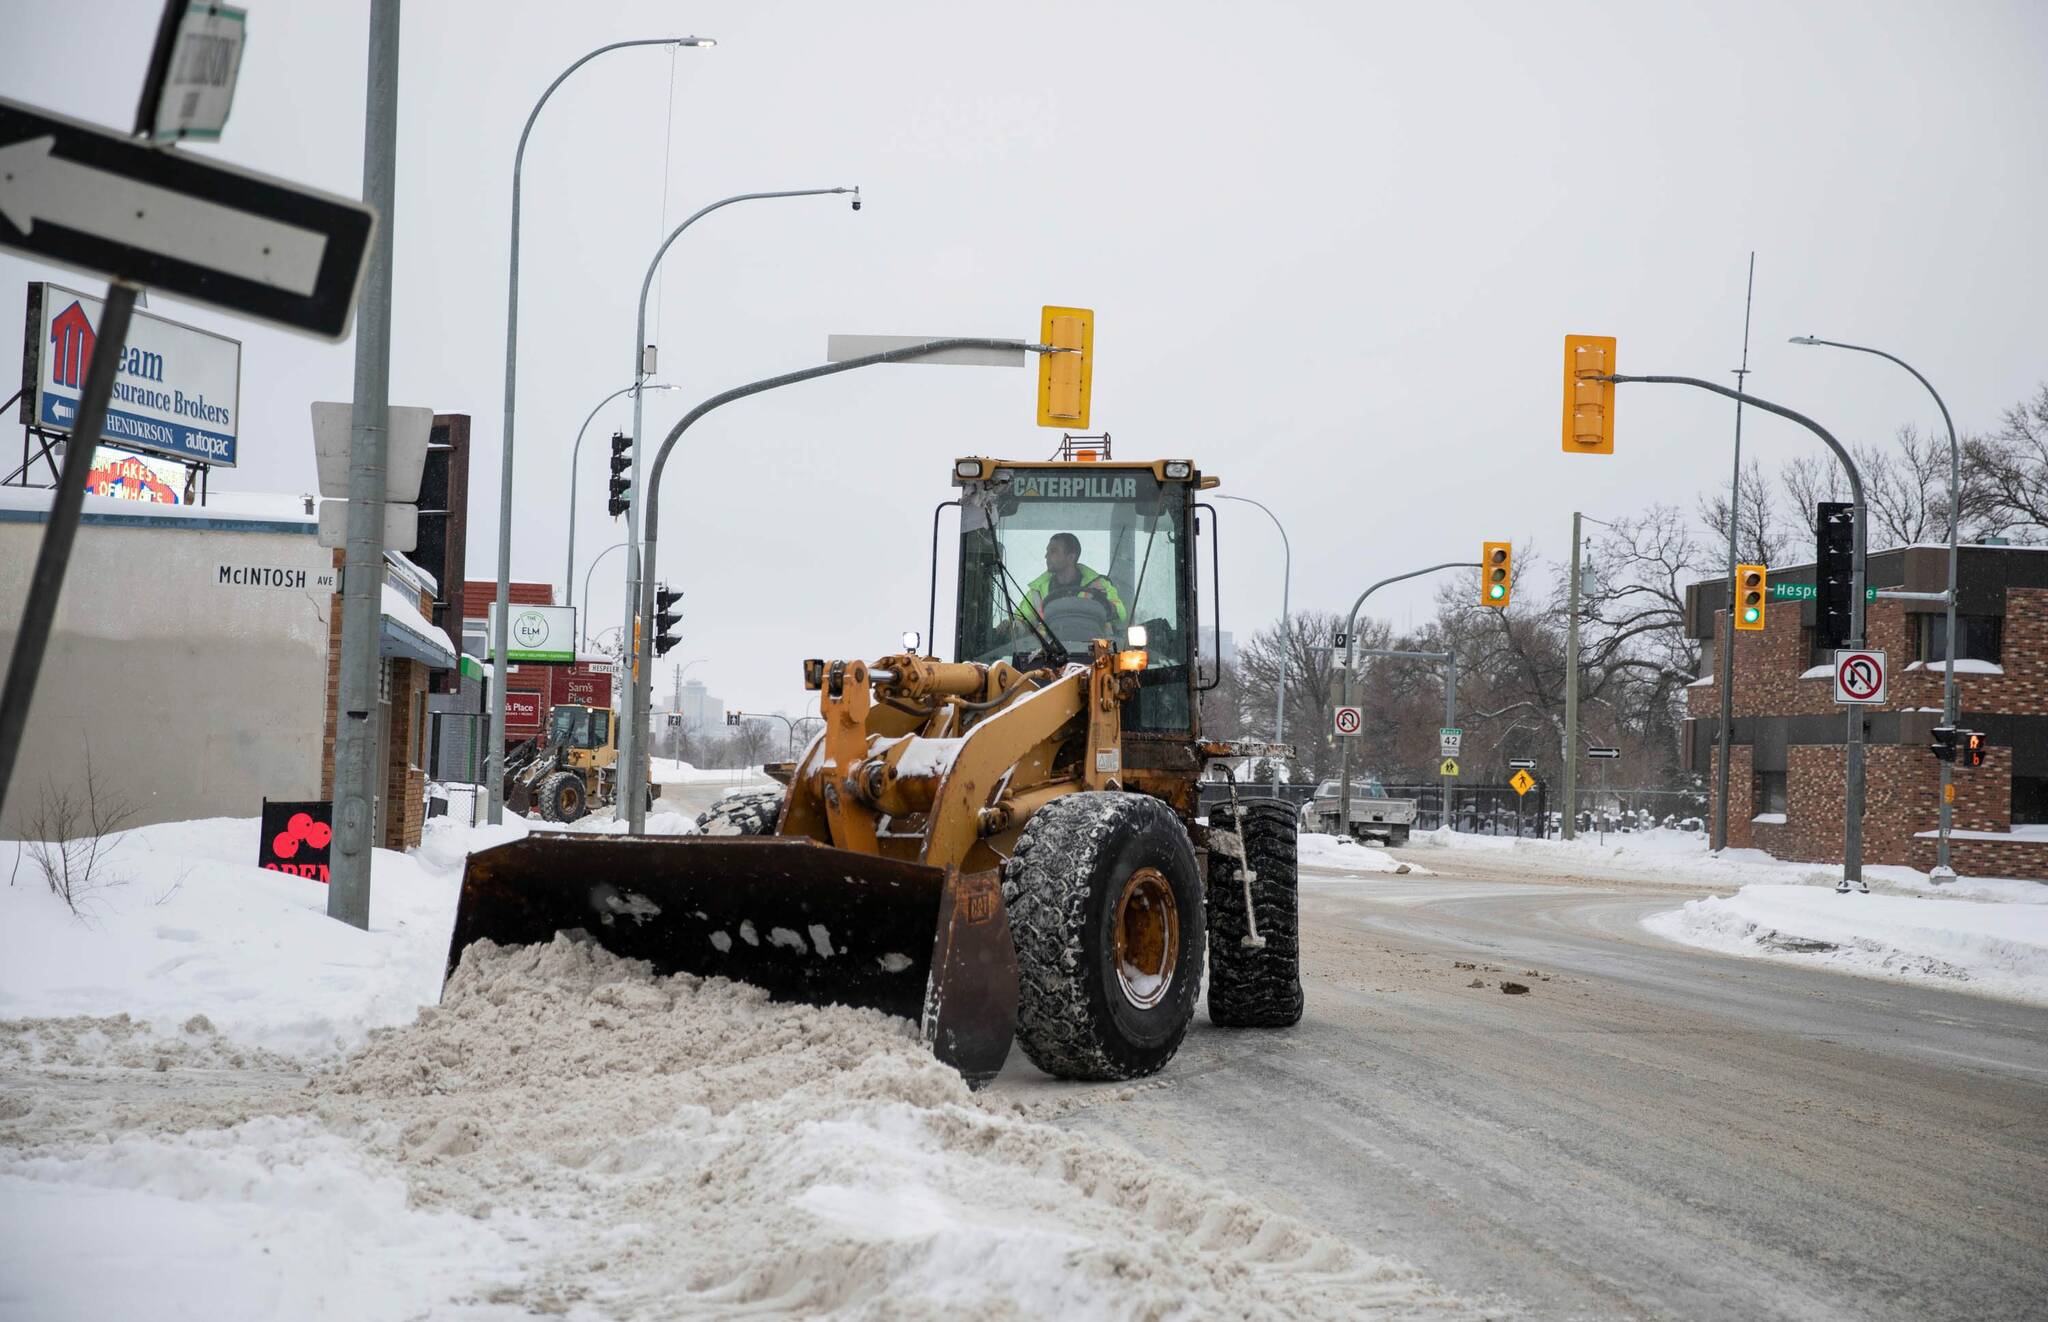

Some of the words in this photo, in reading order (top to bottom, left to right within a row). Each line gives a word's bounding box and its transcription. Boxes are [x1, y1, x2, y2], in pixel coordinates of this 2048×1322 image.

[117, 344, 163, 382] eam
[111, 381, 170, 412] surance
[174, 390, 229, 425] Brokers
[106, 414, 174, 444] HENDERSON
[185, 431, 229, 459] autopac
[1013, 477, 1136, 498] CATERPILLAR
[219, 565, 306, 588] McINTOSH
[317, 576, 333, 586] AVE
[1776, 584, 1818, 599] Hespe
[521, 627, 540, 636] ELM
[592, 664, 620, 673] HESPELER
[568, 682, 593, 692] Sam's
[513, 702, 534, 711] Place
[1444, 736, 1457, 745] 42
